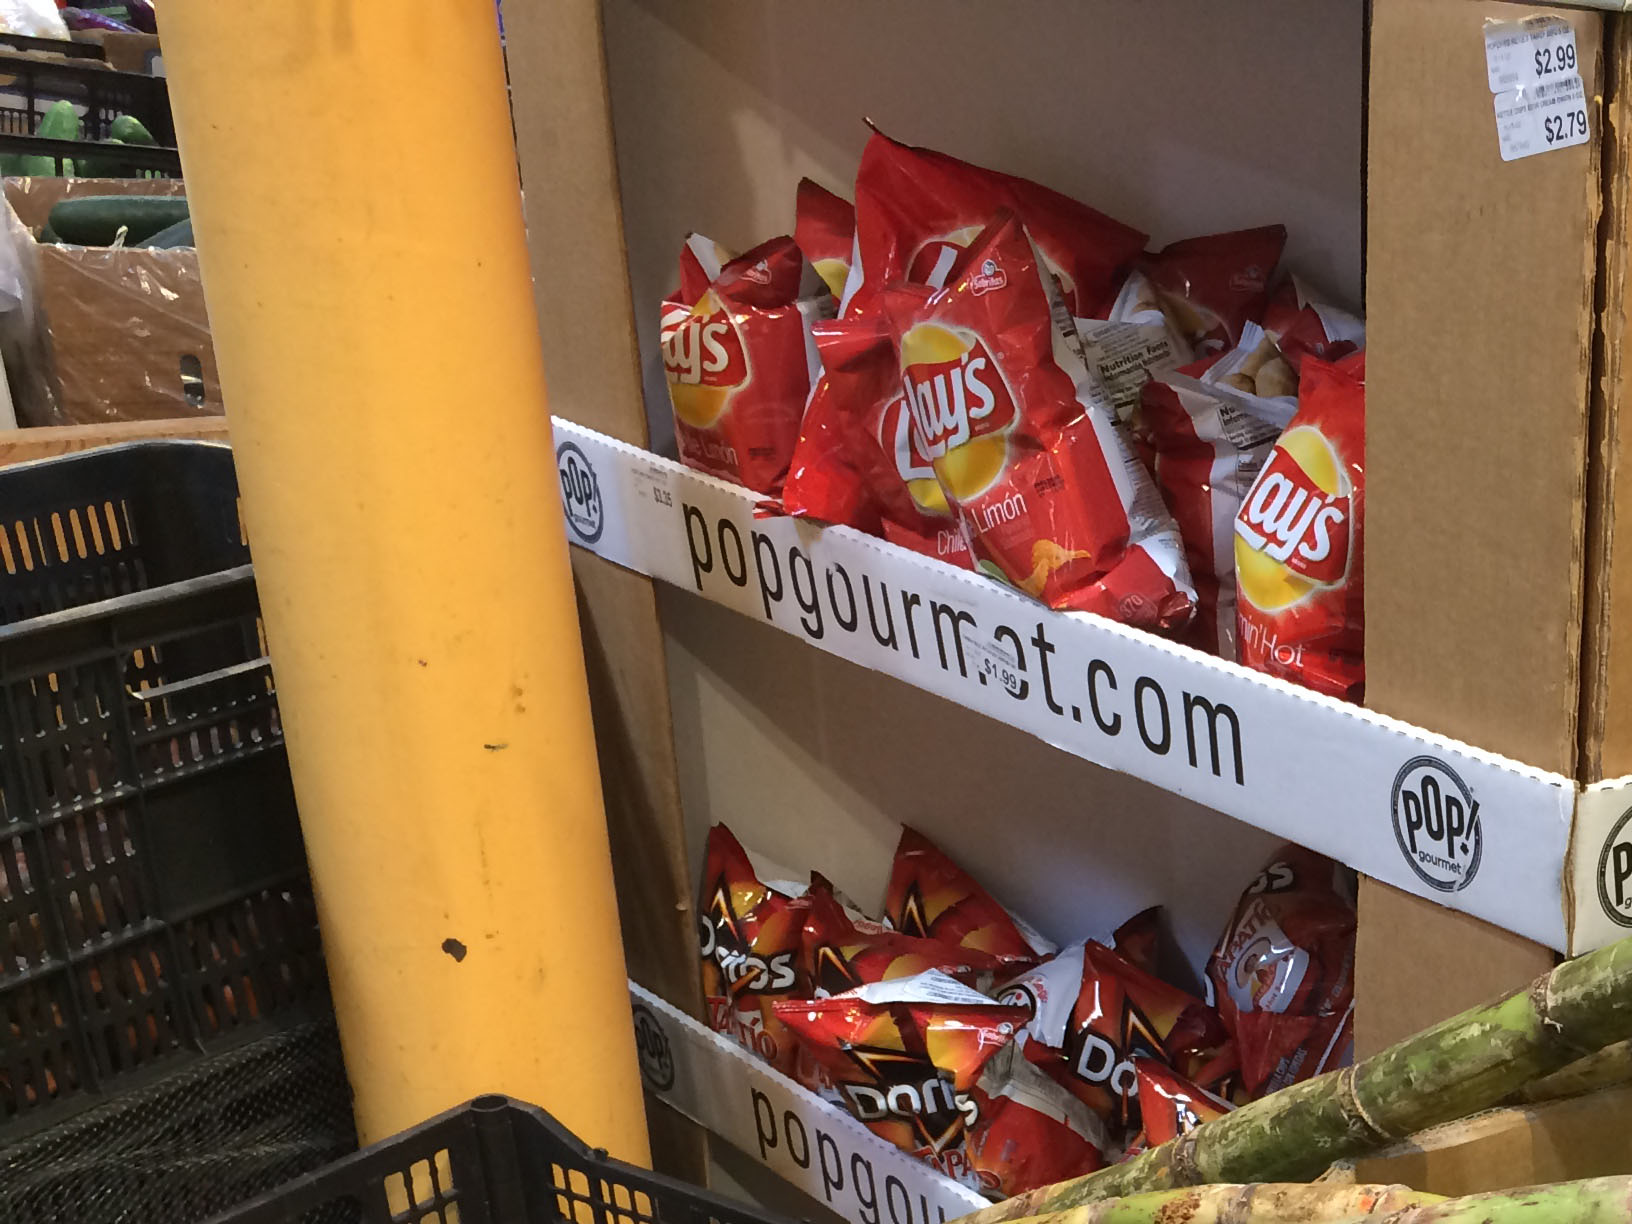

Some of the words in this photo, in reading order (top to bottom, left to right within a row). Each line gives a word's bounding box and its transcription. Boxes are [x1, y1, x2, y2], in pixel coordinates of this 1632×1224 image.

[1534, 43, 1576, 79] $2.99
[1544, 109, 1587, 145] $2.79
[970, 492, 1028, 534] Limón
[1234, 448, 1345, 564] Lay's
[682, 501, 1246, 787] popgourmet.com
[983, 657, 1018, 690] $1.99
[1401, 774, 1481, 860] POP!
[1418, 850, 1463, 876] gourmet
